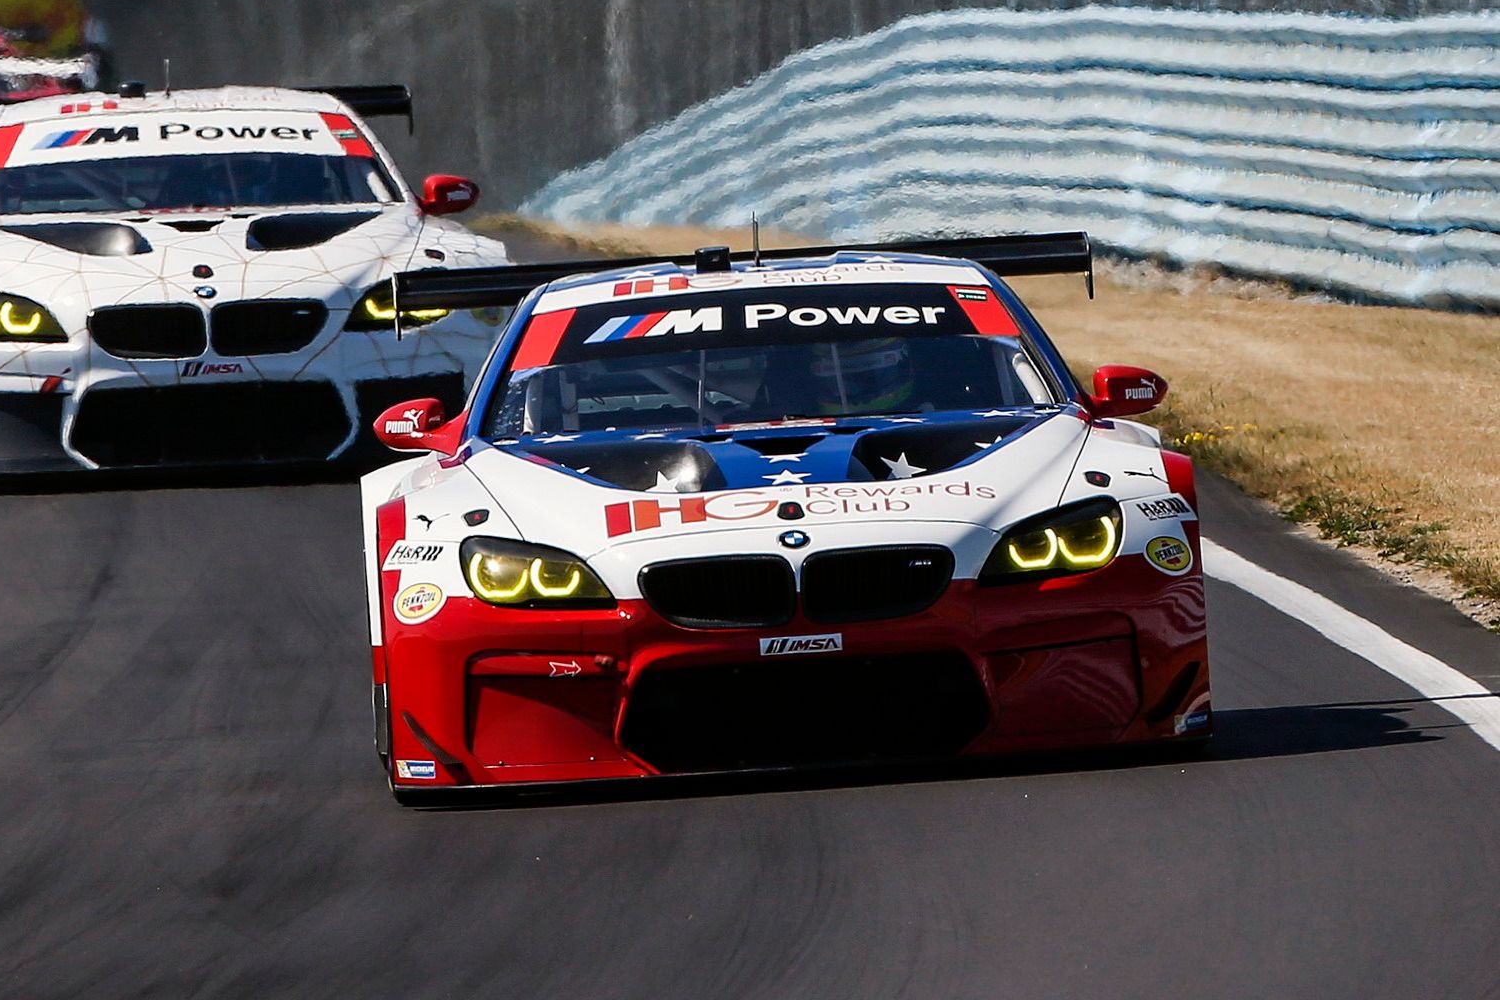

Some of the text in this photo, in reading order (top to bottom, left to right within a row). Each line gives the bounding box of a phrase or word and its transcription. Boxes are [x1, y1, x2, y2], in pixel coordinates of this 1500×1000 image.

[159, 122, 319, 142] Power
[744, 303, 946, 330] Power
[1124, 387, 1154, 400] PUMA
[385, 420, 414, 434] PUMA
[605, 481, 997, 539] IHG Rewards
[805, 498, 911, 515] Club
[1136, 500, 1173, 518] H&R
[391, 545, 426, 561] H&R
[787, 637, 839, 652] IMSA
